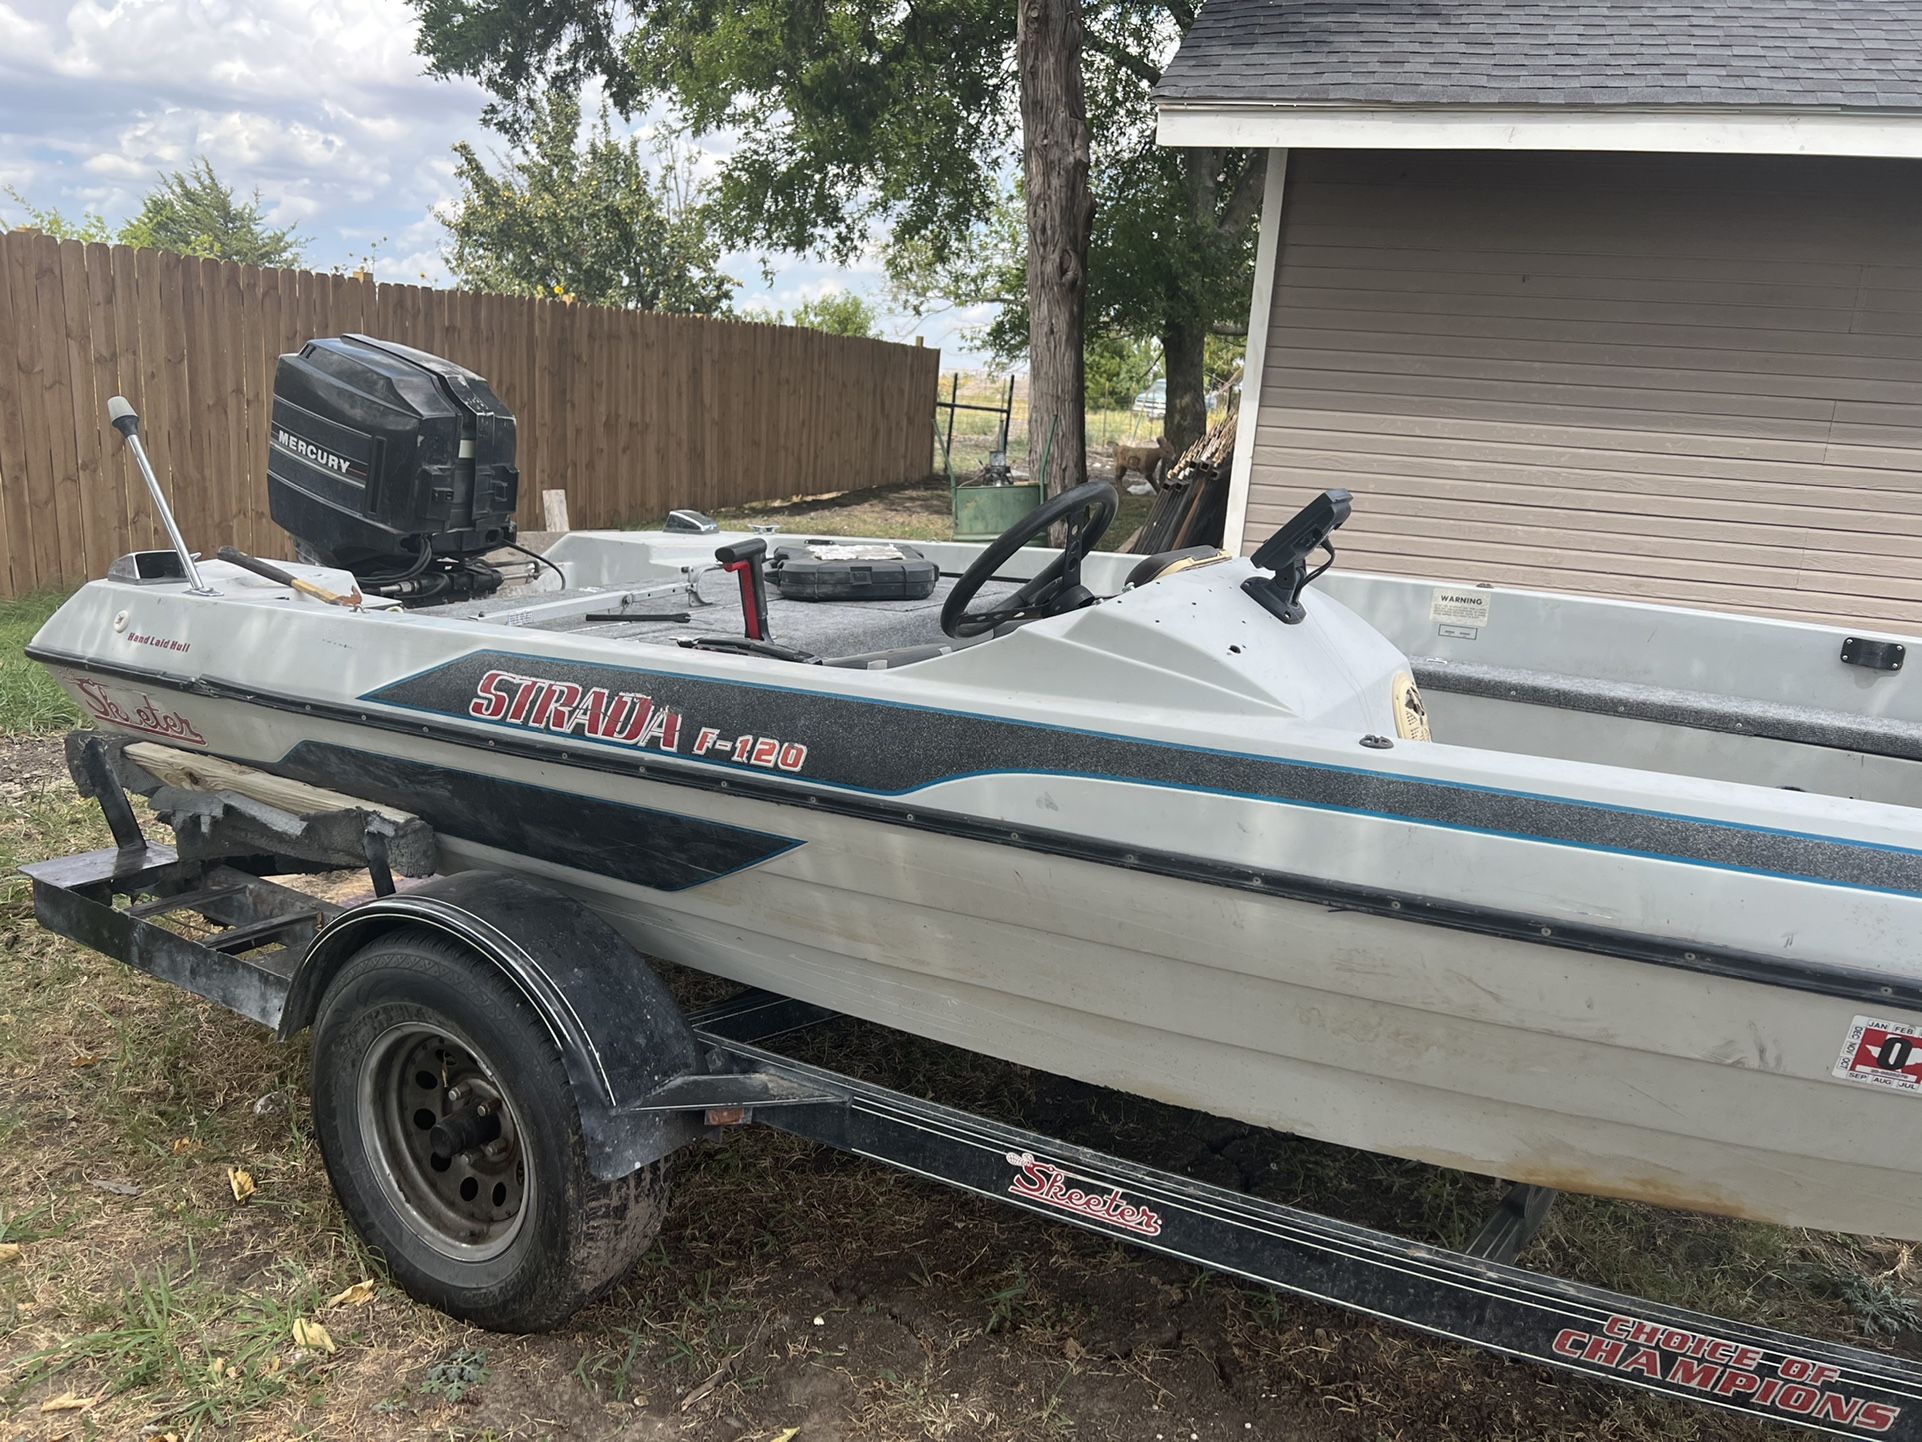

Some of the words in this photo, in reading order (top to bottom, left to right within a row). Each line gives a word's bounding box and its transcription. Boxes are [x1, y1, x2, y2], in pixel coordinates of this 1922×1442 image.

[278, 430, 350, 473] MERCURY
[1441, 595, 1482, 605] WARNING
[128, 632, 150, 644] Hand
[150, 637, 170, 648] Laid
[170, 641, 190, 652] Hull
[76, 679, 207, 746] Sketer
[469, 670, 682, 753] STRADA
[692, 727, 807, 772] F-120
[1868, 1022, 1888, 1030] JAN
[1894, 1026, 1914, 1035] FEB
[1848, 1072, 1867, 1080] SEP
[1873, 1077, 1892, 1085] AUG
[1898, 1082, 1916, 1090] JUL
[1008, 1161, 1162, 1236] Skeeter
[1603, 1315, 1763, 1369] CHOICE
[1777, 1357, 1841, 1386] OF
[1551, 1327, 1901, 1432] CHAMPIONS
